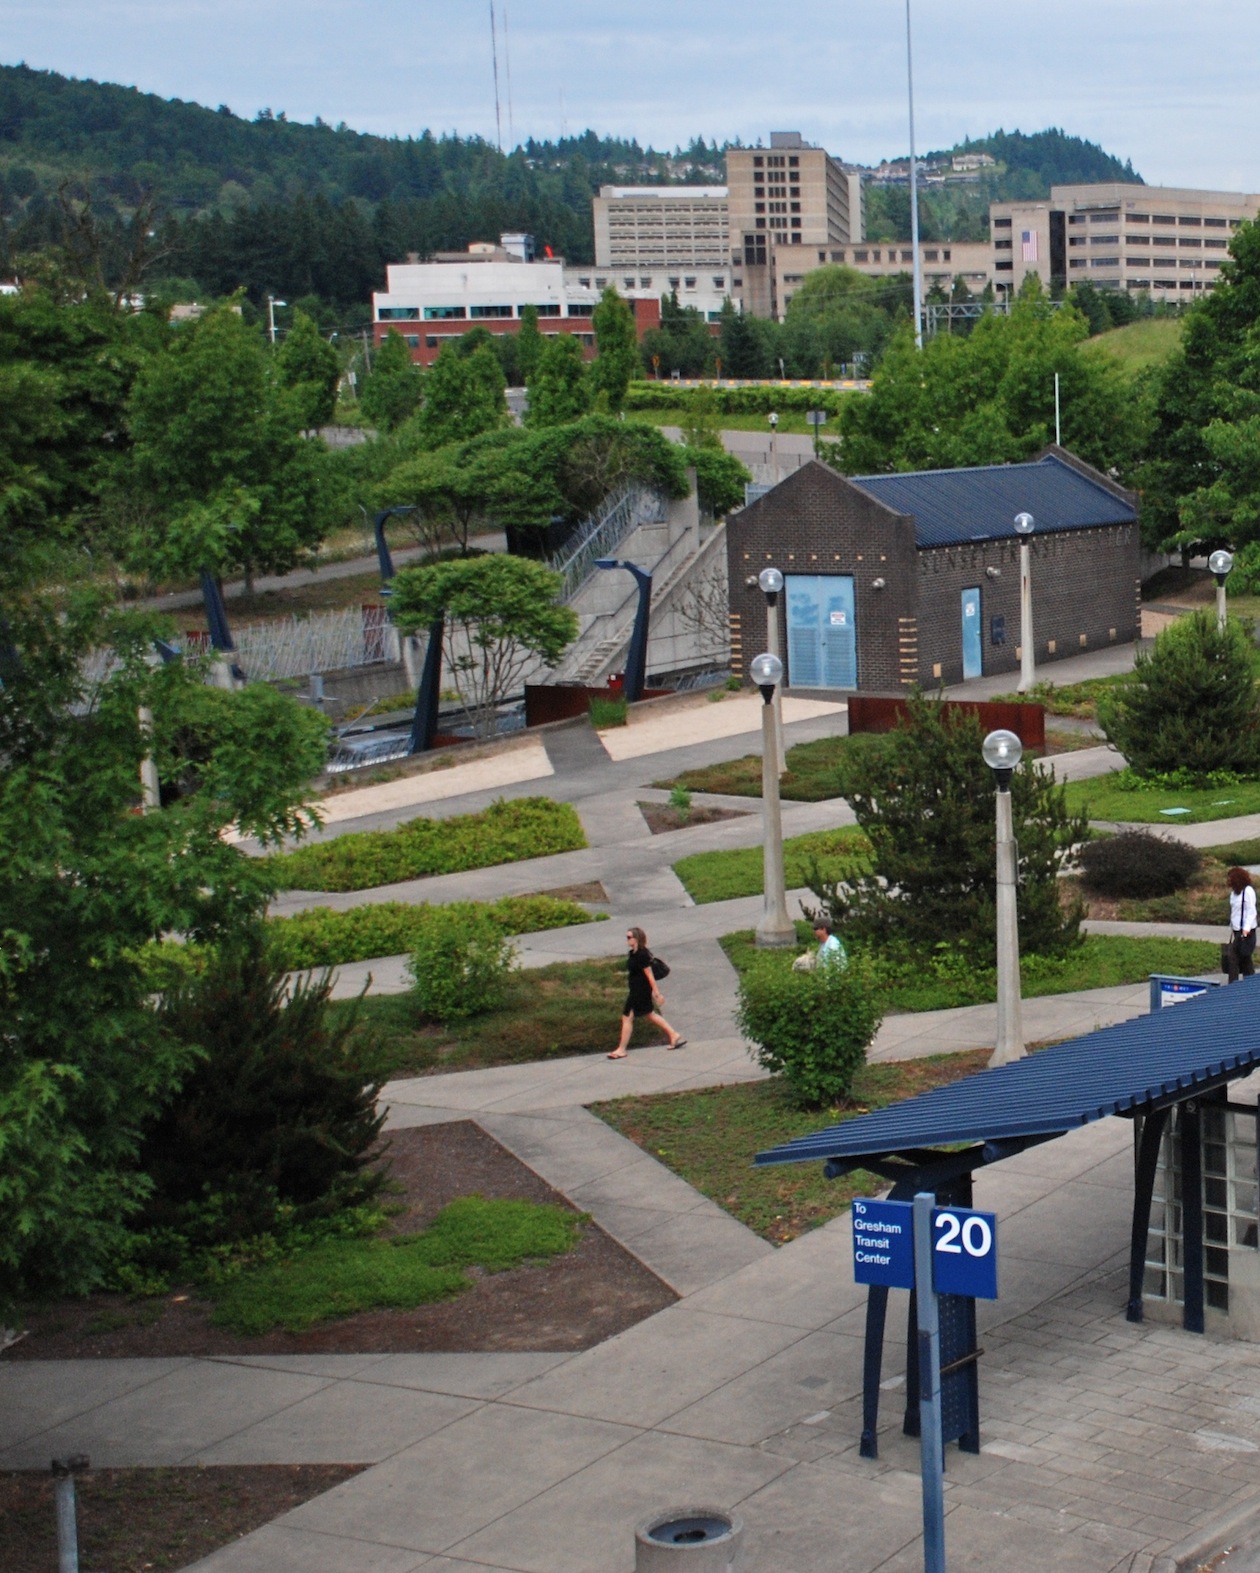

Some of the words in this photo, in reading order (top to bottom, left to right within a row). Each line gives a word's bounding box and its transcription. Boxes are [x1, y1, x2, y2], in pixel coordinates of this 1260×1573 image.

[920, 548, 988, 576] SUNSET
[854, 1202, 866, 1214] To
[854, 1219, 902, 1234] Gresham
[855, 1235, 890, 1249] Transit
[935, 1212, 992, 1258] 20
[855, 1251, 891, 1265] Center
